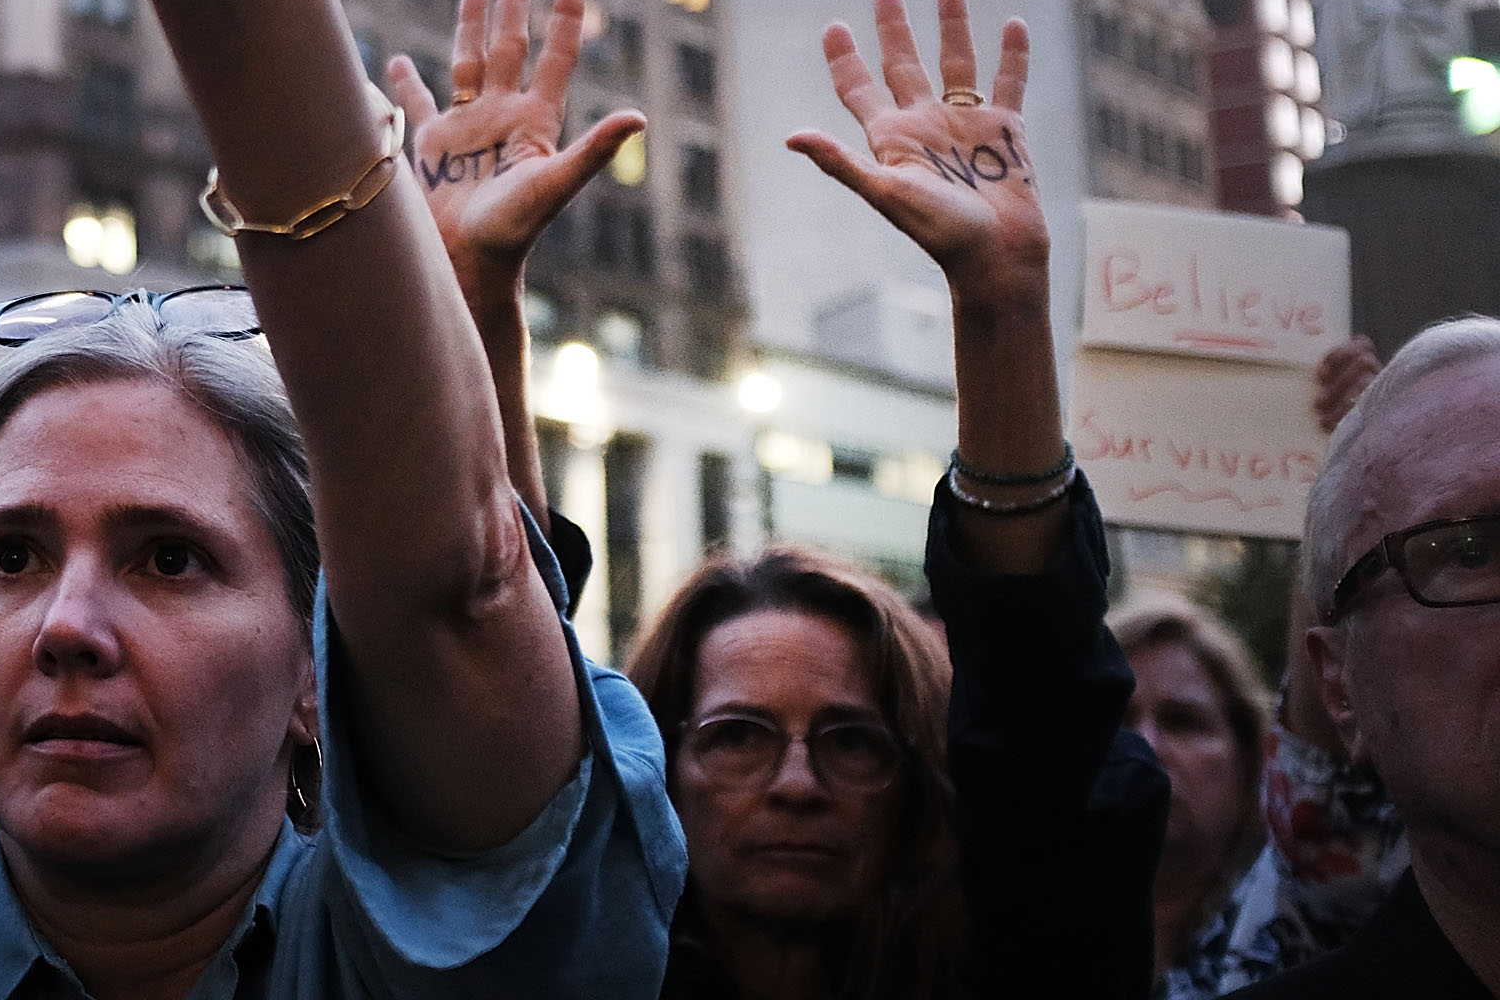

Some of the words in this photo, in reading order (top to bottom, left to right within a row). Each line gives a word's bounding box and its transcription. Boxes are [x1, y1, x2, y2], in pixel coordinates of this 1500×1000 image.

[420, 141, 513, 191] VOTE
[923, 125, 1030, 190] NO!
[1103, 249, 1325, 336] Believe
